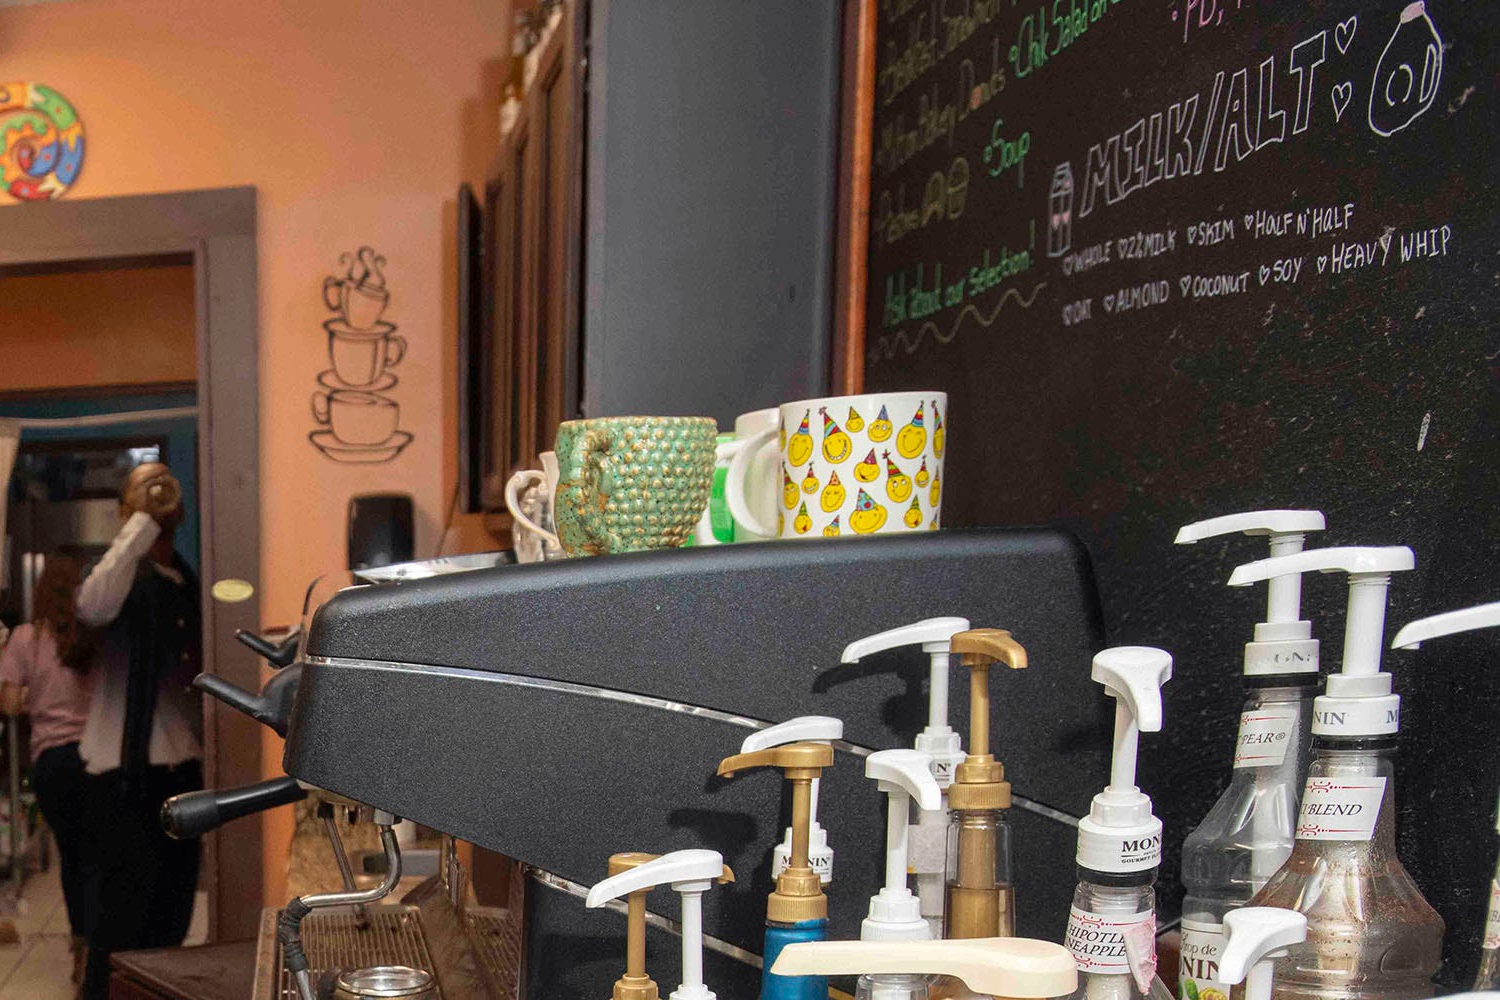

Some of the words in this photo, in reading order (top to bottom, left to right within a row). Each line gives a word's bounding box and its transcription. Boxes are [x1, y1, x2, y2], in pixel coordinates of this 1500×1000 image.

[1078, 29, 1327, 218] MILK/ALT
[988, 118, 1031, 188] Soup
[1074, 240, 1113, 273] WHOLE
[1198, 218, 1235, 247] SKIM
[1073, 299, 1093, 326] OAT
[1115, 280, 1170, 313] ALMOND
[1193, 271, 1250, 298] COCONUT
[1273, 256, 1303, 284] SOY
[1331, 234, 1392, 274] HEAVY
[1400, 224, 1451, 263] WHIP
[1308, 803, 1363, 816] BLEND
[782, 856, 829, 868] MNIN
[1201, 944, 1217, 956] de
